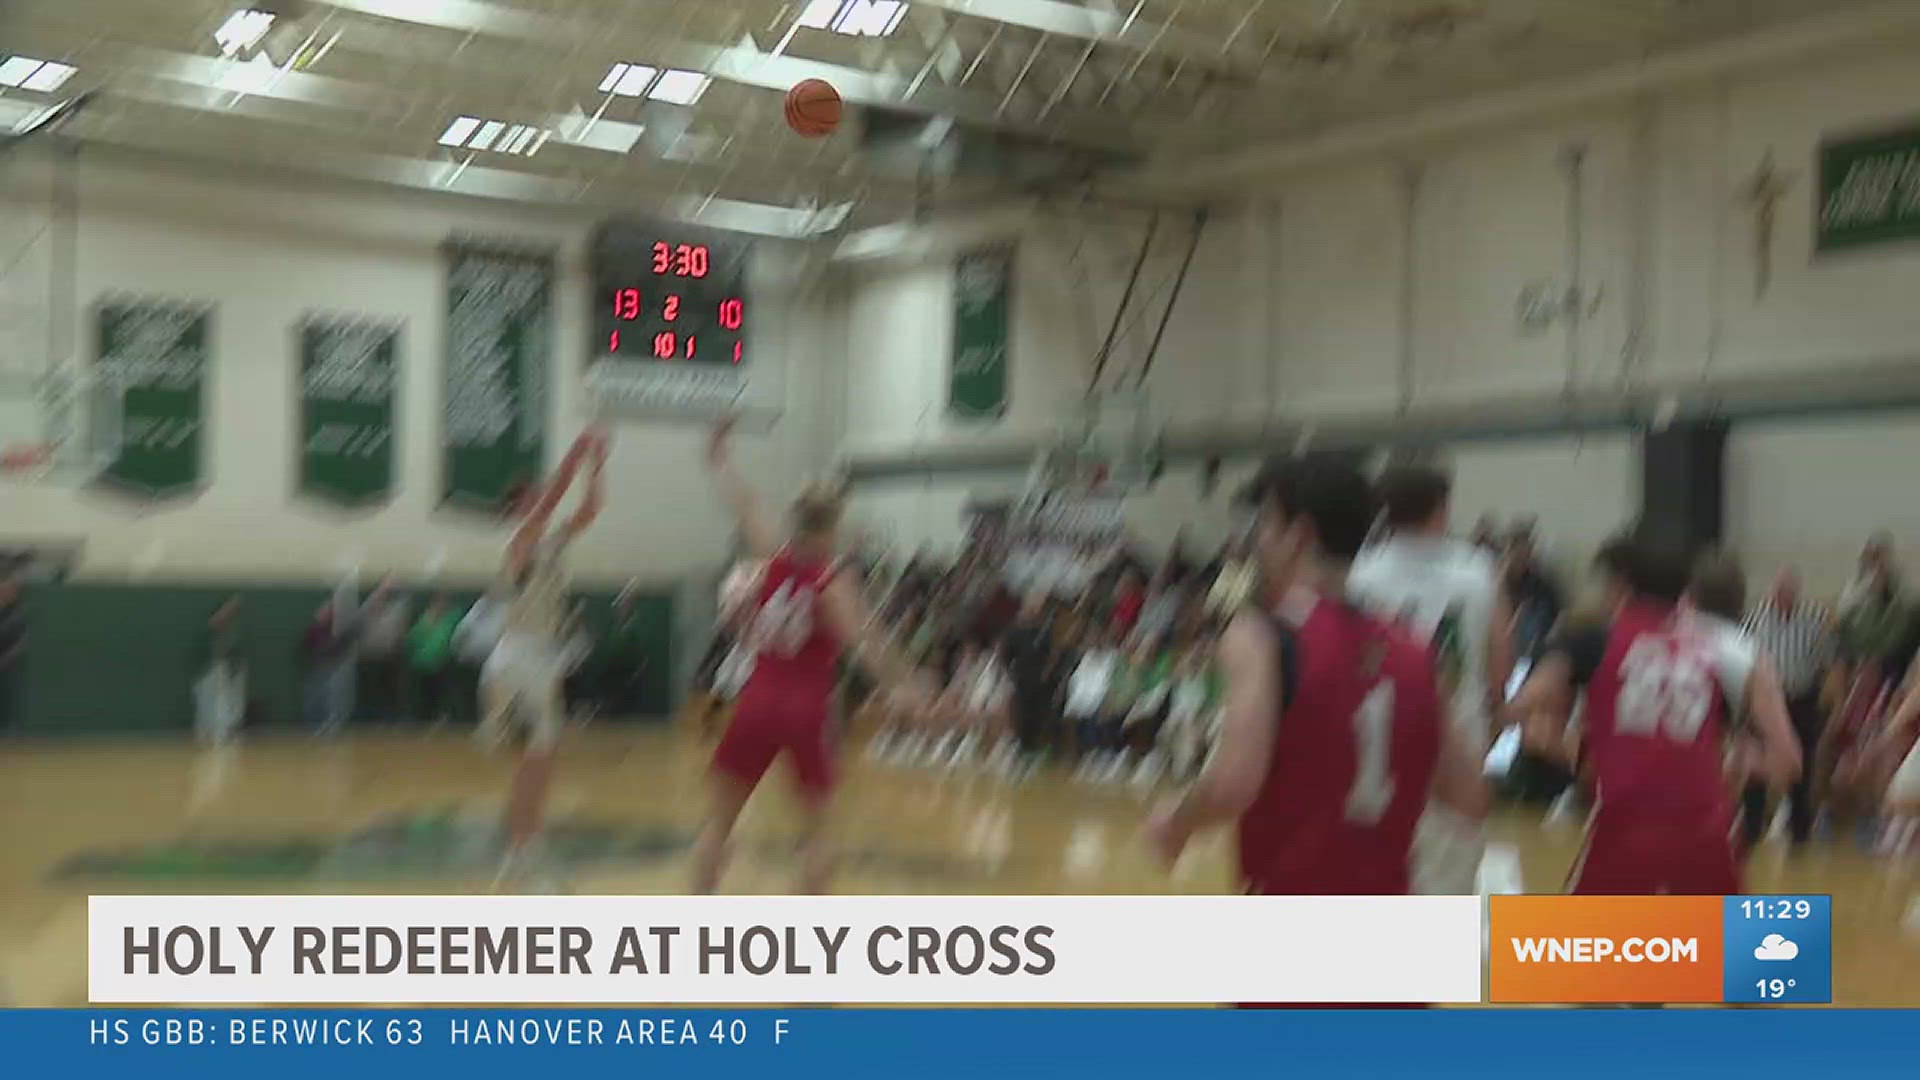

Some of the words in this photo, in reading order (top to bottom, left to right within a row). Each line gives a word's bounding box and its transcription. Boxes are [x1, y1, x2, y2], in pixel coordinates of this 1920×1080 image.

[652, 240, 709, 278] 3:30
[614, 288, 641, 320] 13
[663, 294, 680, 321] 2
[718, 297, 744, 330] 10
[653, 330, 676, 359] 10
[685, 335, 697, 360] 1
[1345, 676, 1397, 827] 1
